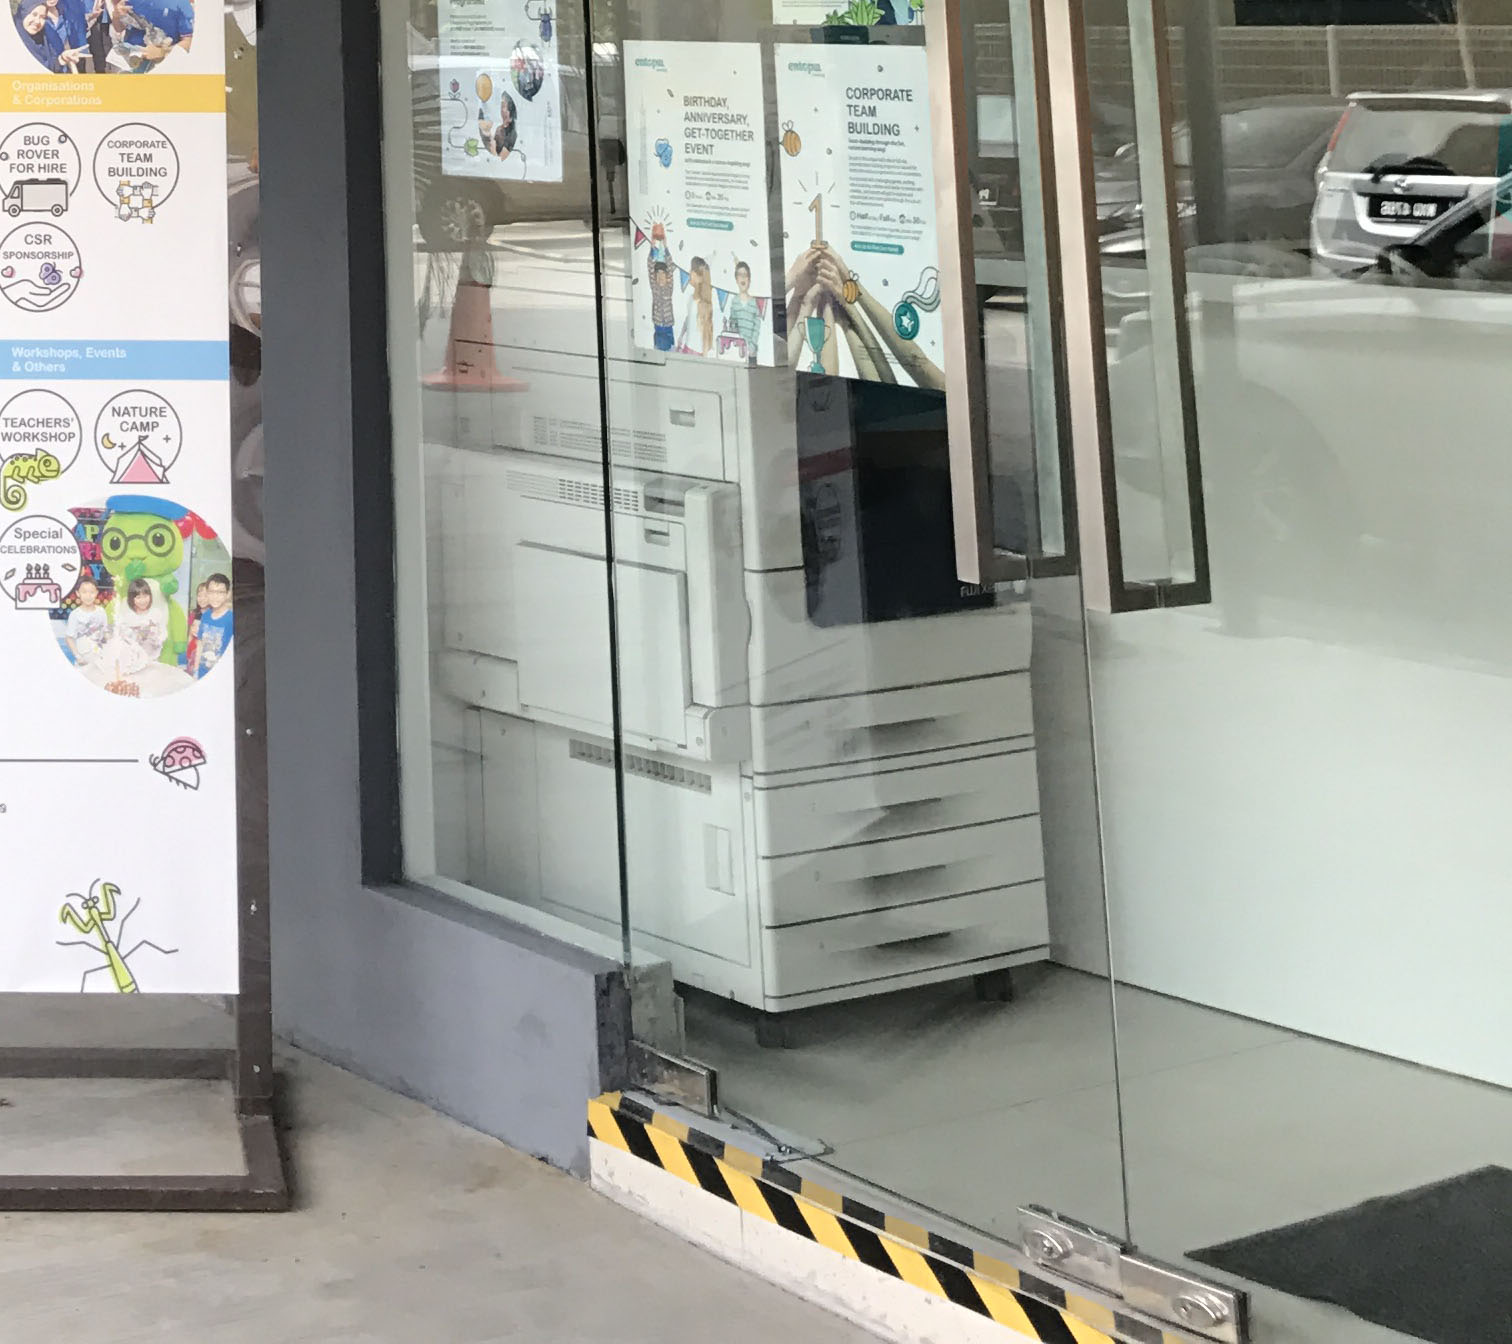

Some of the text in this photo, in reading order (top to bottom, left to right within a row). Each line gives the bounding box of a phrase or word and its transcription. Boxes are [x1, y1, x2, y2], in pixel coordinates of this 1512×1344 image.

[12, 80, 95, 93] Organisations
[846, 87, 913, 102] CORPORATE
[12, 95, 102, 108] & Corporations
[683, 96, 730, 110] BIRTHDAY,
[846, 104, 877, 117] TEAM
[684, 112, 749, 127] ANNIVERSARY,
[684, 127, 754, 141] GET-TOGETHER
[847, 122, 901, 136] BUILDING
[23, 136, 50, 146] BUG
[107, 140, 168, 149] CORPORATE
[685, 143, 715, 155] EVENT
[17, 150, 59, 160] ROVER
[118, 153, 153, 163] TEAM
[9, 163, 67, 174] FOR HIRE
[108, 167, 168, 177] BUILDING
[24, 234, 52, 245] CSR
[2, 251, 74, 260] SPONSORSHIP
[12, 347, 127, 360] Workshops, Events
[12, 361, 66, 373] & Others
[111, 407, 168, 418] NATURE
[2, 417, 75, 428] TEACHERS'
[119, 421, 160, 432] CAMP
[1, 431, 76, 442] WORKSHOP
[14, 527, 63, 542] Special
[0, 545, 77, 554] CELEBRATIONS
